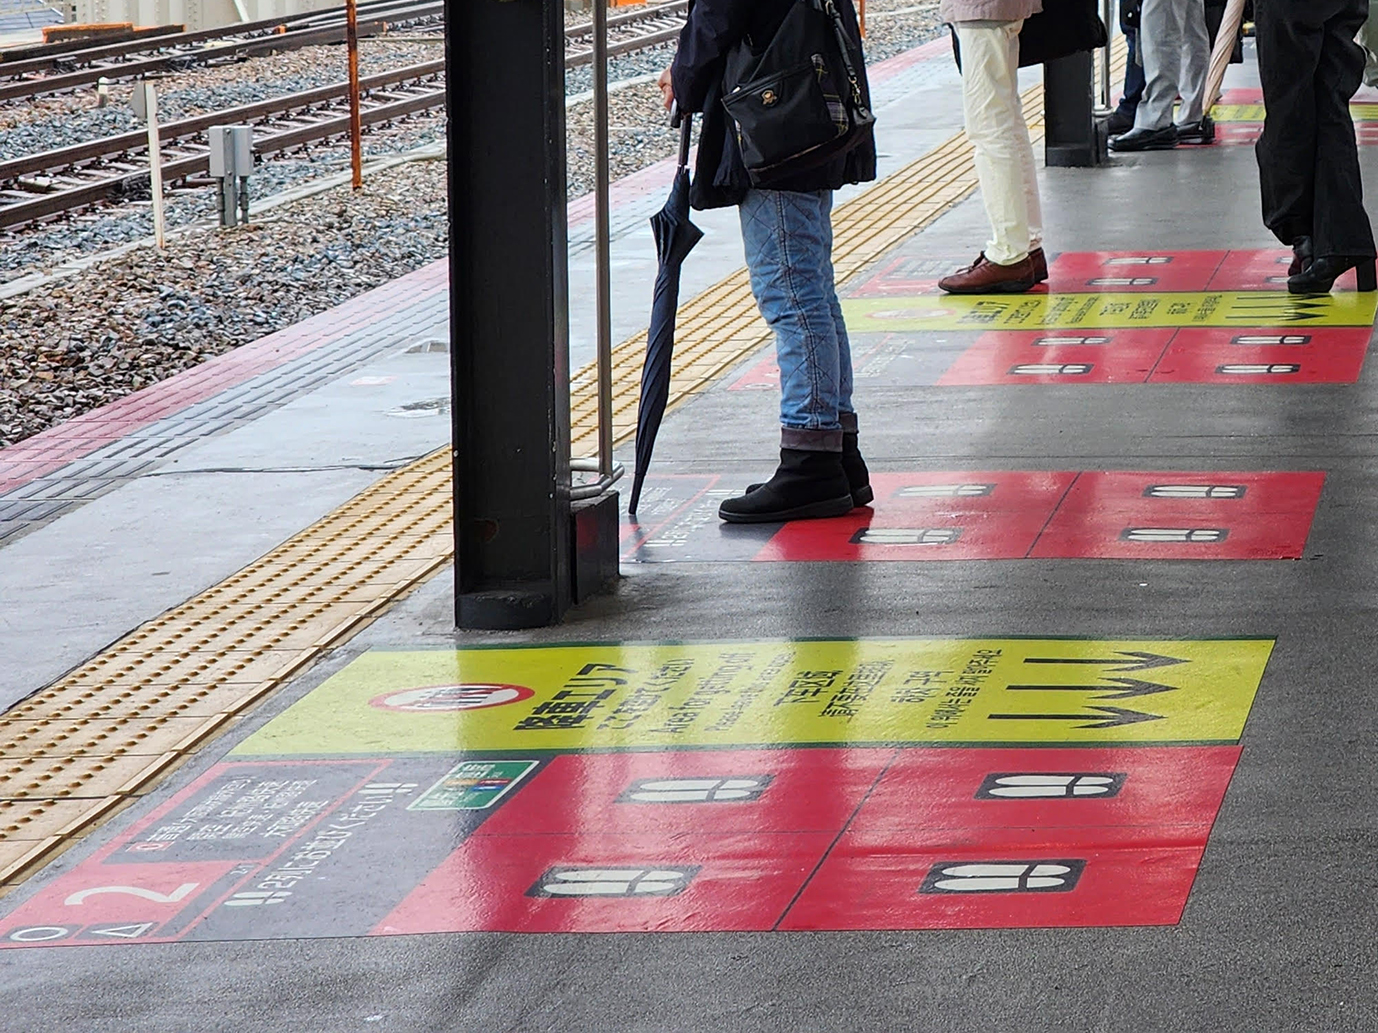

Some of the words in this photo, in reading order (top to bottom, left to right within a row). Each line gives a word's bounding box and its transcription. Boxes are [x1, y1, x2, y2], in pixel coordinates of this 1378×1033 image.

[681, 664, 755, 695] getting
[508, 661, 649, 731] 降車エリア
[663, 696, 715, 711] for
[644, 711, 702, 734] Area
[258, 795, 394, 888] 2列にお並びください
[64, 881, 200, 906] 2
